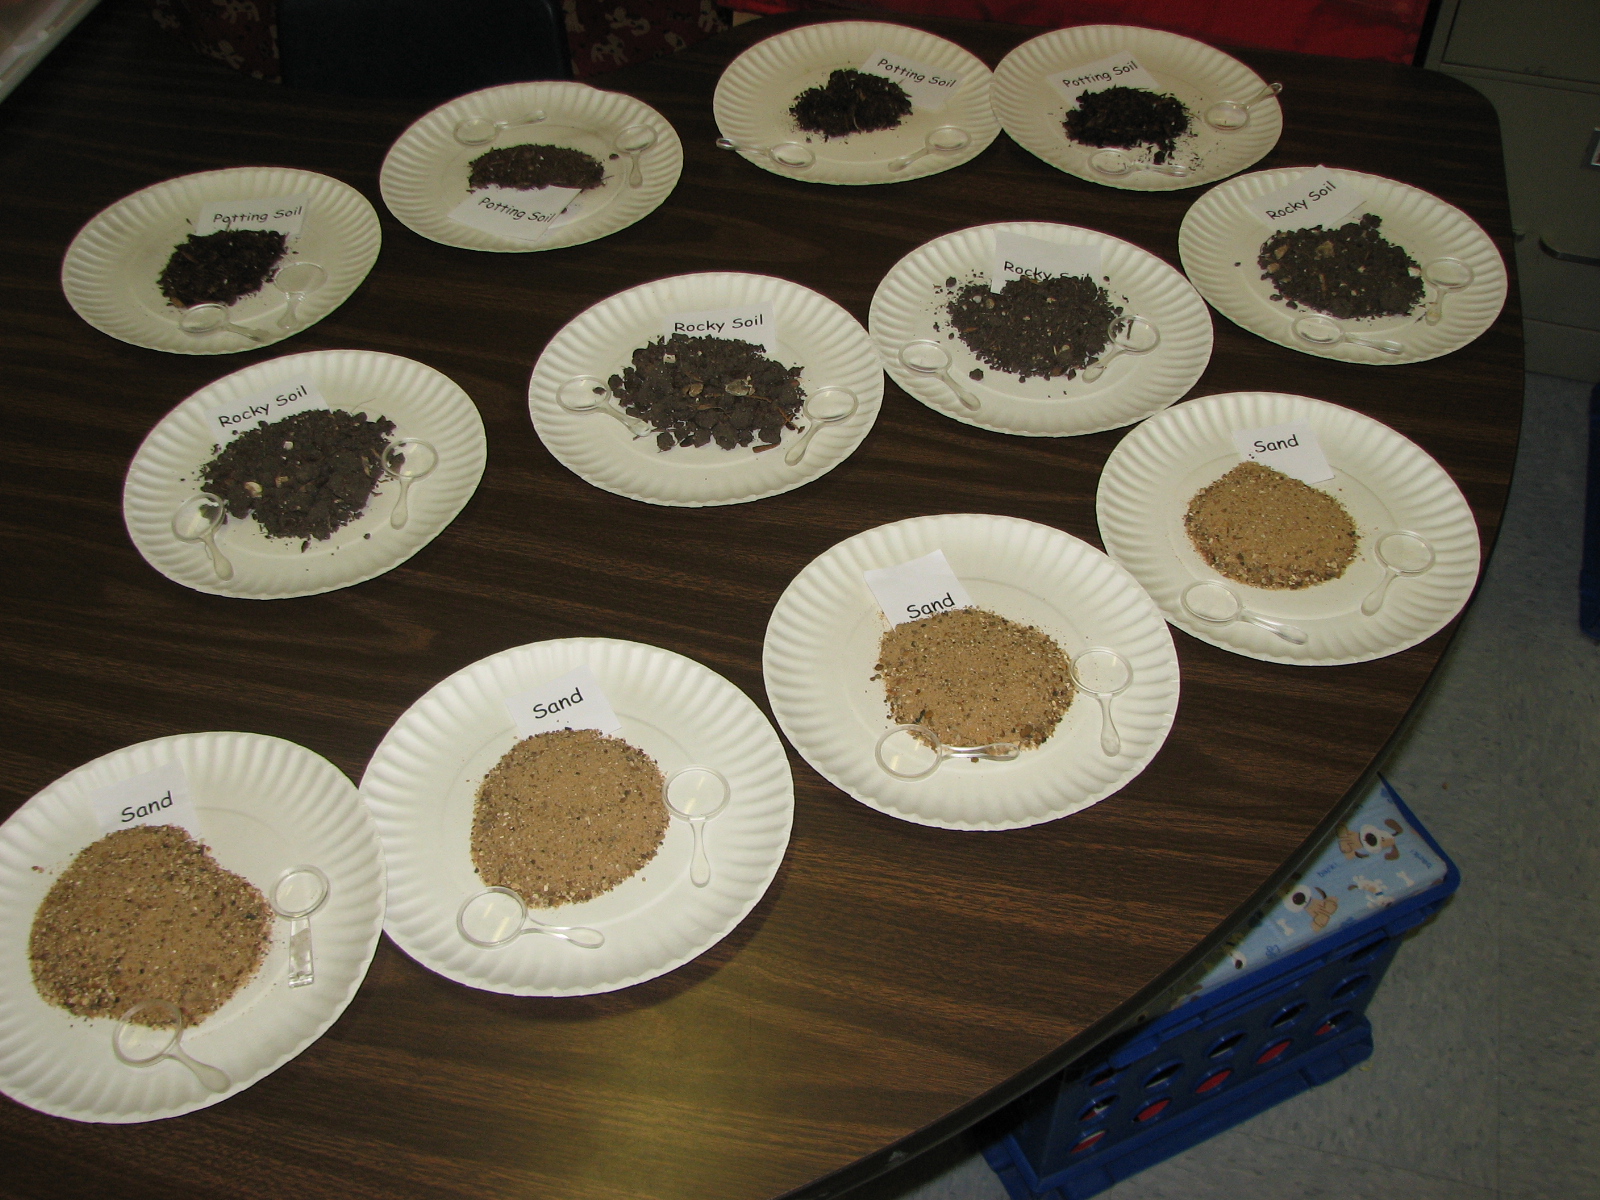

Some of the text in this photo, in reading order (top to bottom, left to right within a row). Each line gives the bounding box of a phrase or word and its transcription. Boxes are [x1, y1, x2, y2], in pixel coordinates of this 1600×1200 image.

[877, 58, 957, 88] Potting Soil
[1062, 60, 1139, 88] Potting Soil
[478, 197, 557, 224] Potting Soil
[1266, 180, 1337, 221] Rocky Soil
[213, 206, 303, 224] Potting Soil
[674, 313, 764, 334] Rocky Soil
[218, 384, 308, 428] Rocky Soil
[1253, 433, 1299, 453] Sand
[906, 592, 956, 619] Sand
[533, 686, 584, 719] Sand
[121, 790, 174, 823] Sand
